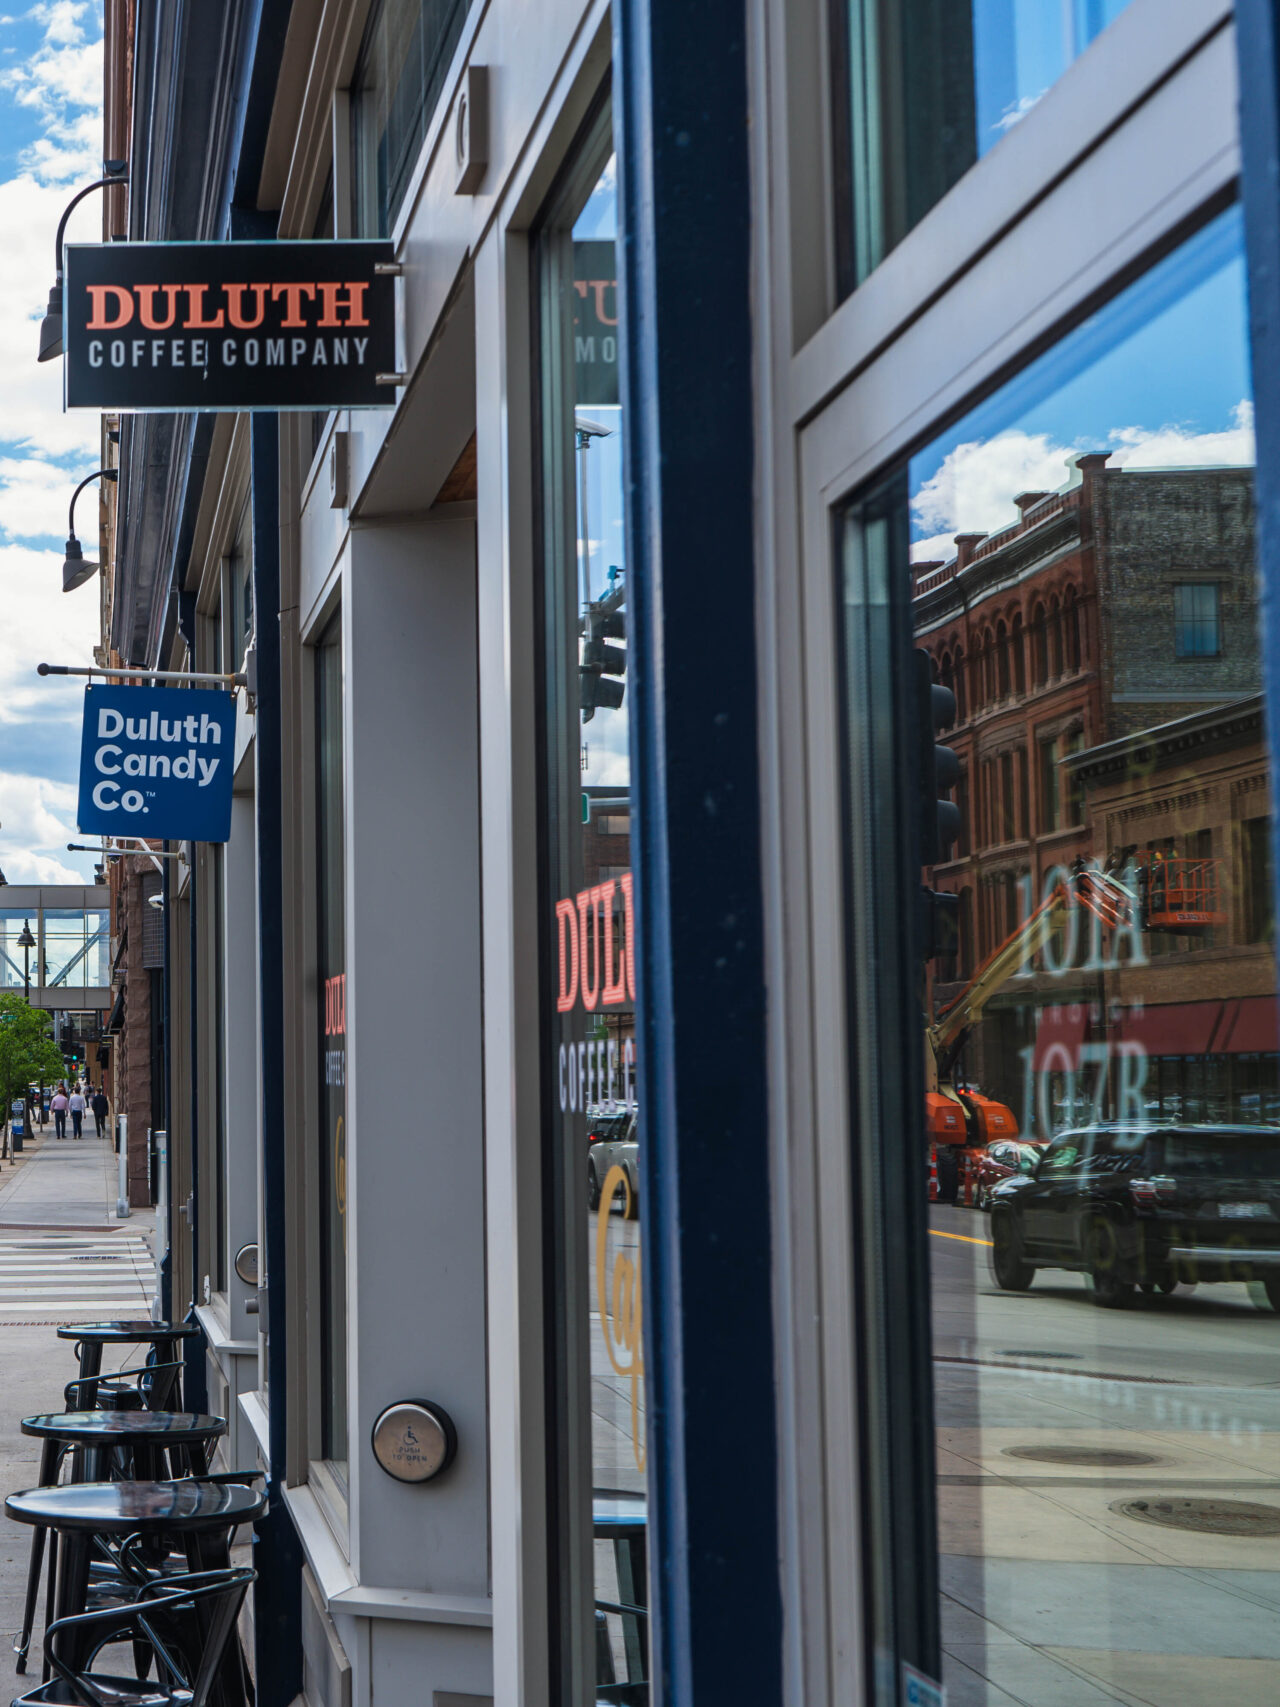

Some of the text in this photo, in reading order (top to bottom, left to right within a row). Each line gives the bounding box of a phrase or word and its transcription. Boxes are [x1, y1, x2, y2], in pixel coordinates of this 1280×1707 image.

[86, 282, 369, 330] DULUTH
[88, 337, 368, 367] COFFEE COMPANY
[97, 708, 222, 744] Duluth
[94, 744, 220, 787] Candy
[1016, 860, 1150, 980] 101A
[559, 1039, 617, 1113] COFFEE
